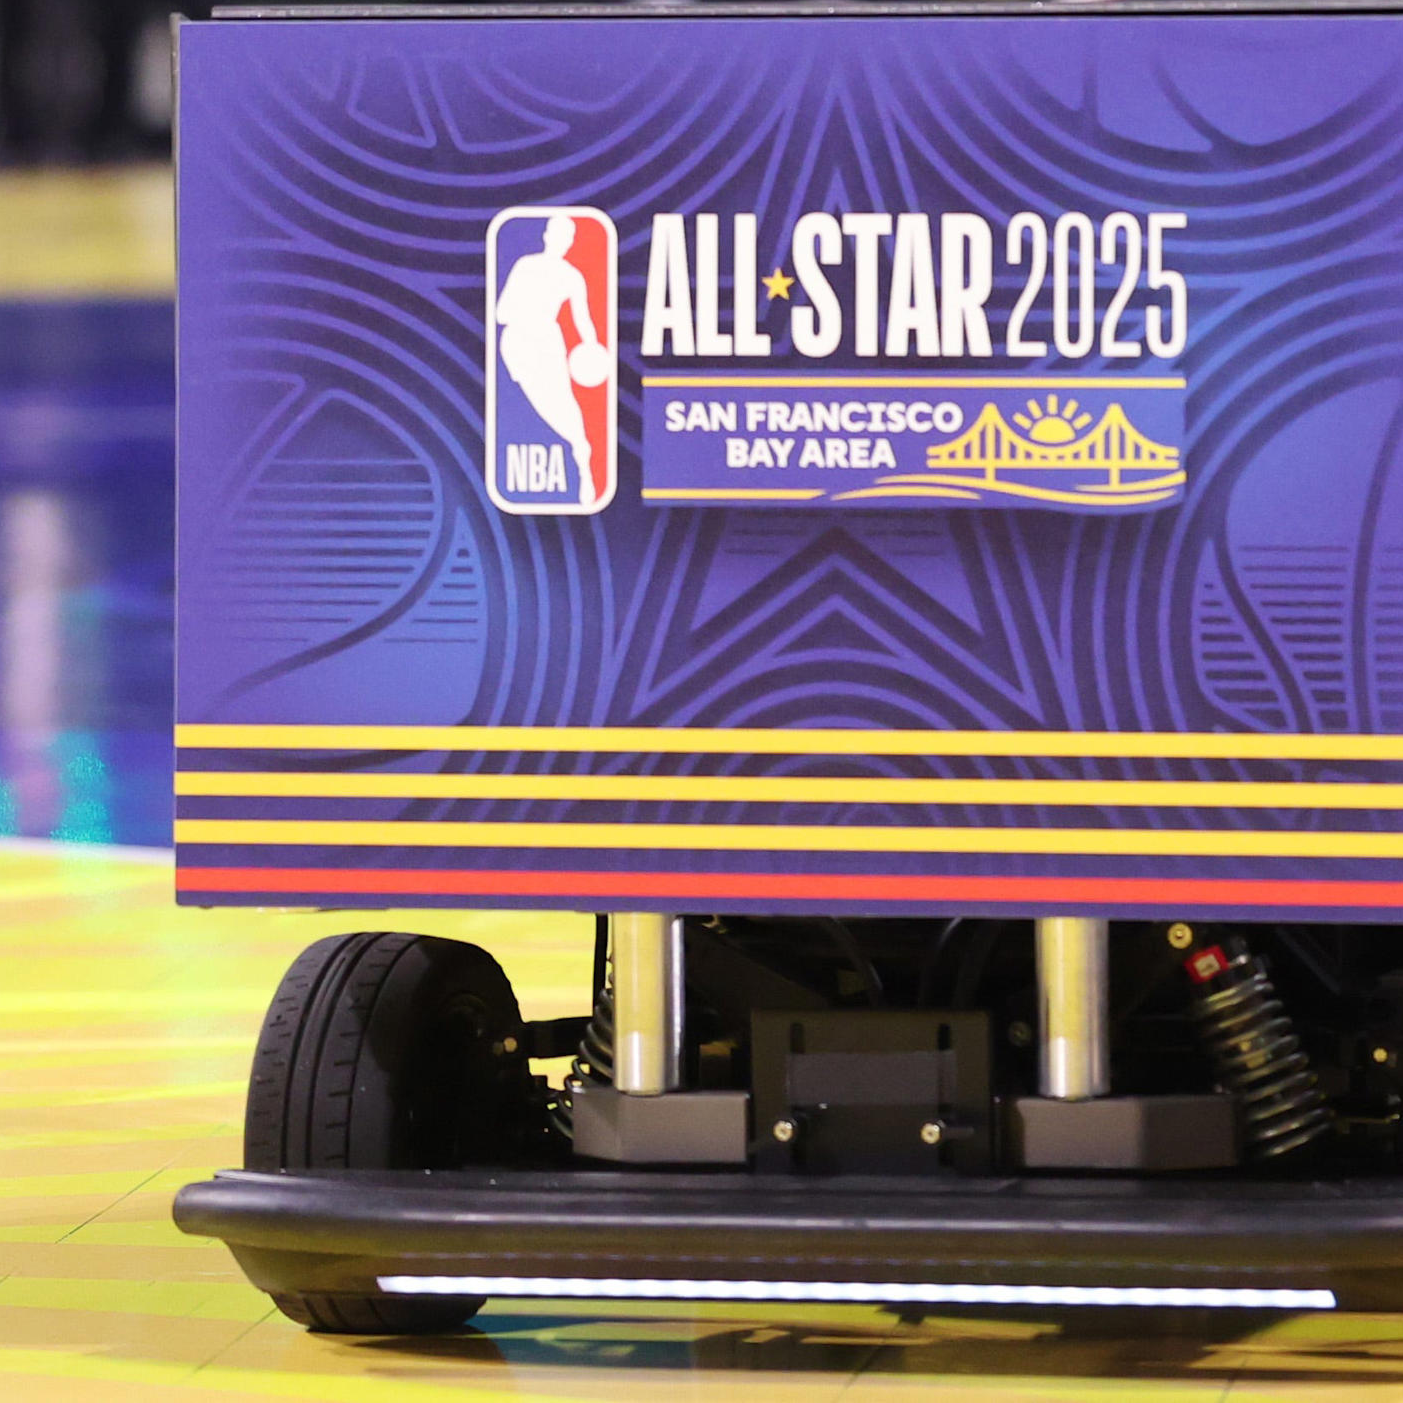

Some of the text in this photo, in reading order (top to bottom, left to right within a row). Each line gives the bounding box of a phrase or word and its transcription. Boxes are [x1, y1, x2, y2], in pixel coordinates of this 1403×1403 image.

[640, 212, 1188, 359] ALL STAR 2025
[665, 401, 963, 433] SAN FRANCISCO
[505, 443, 567, 494] NBA
[725, 438, 897, 469] BAY AREA
